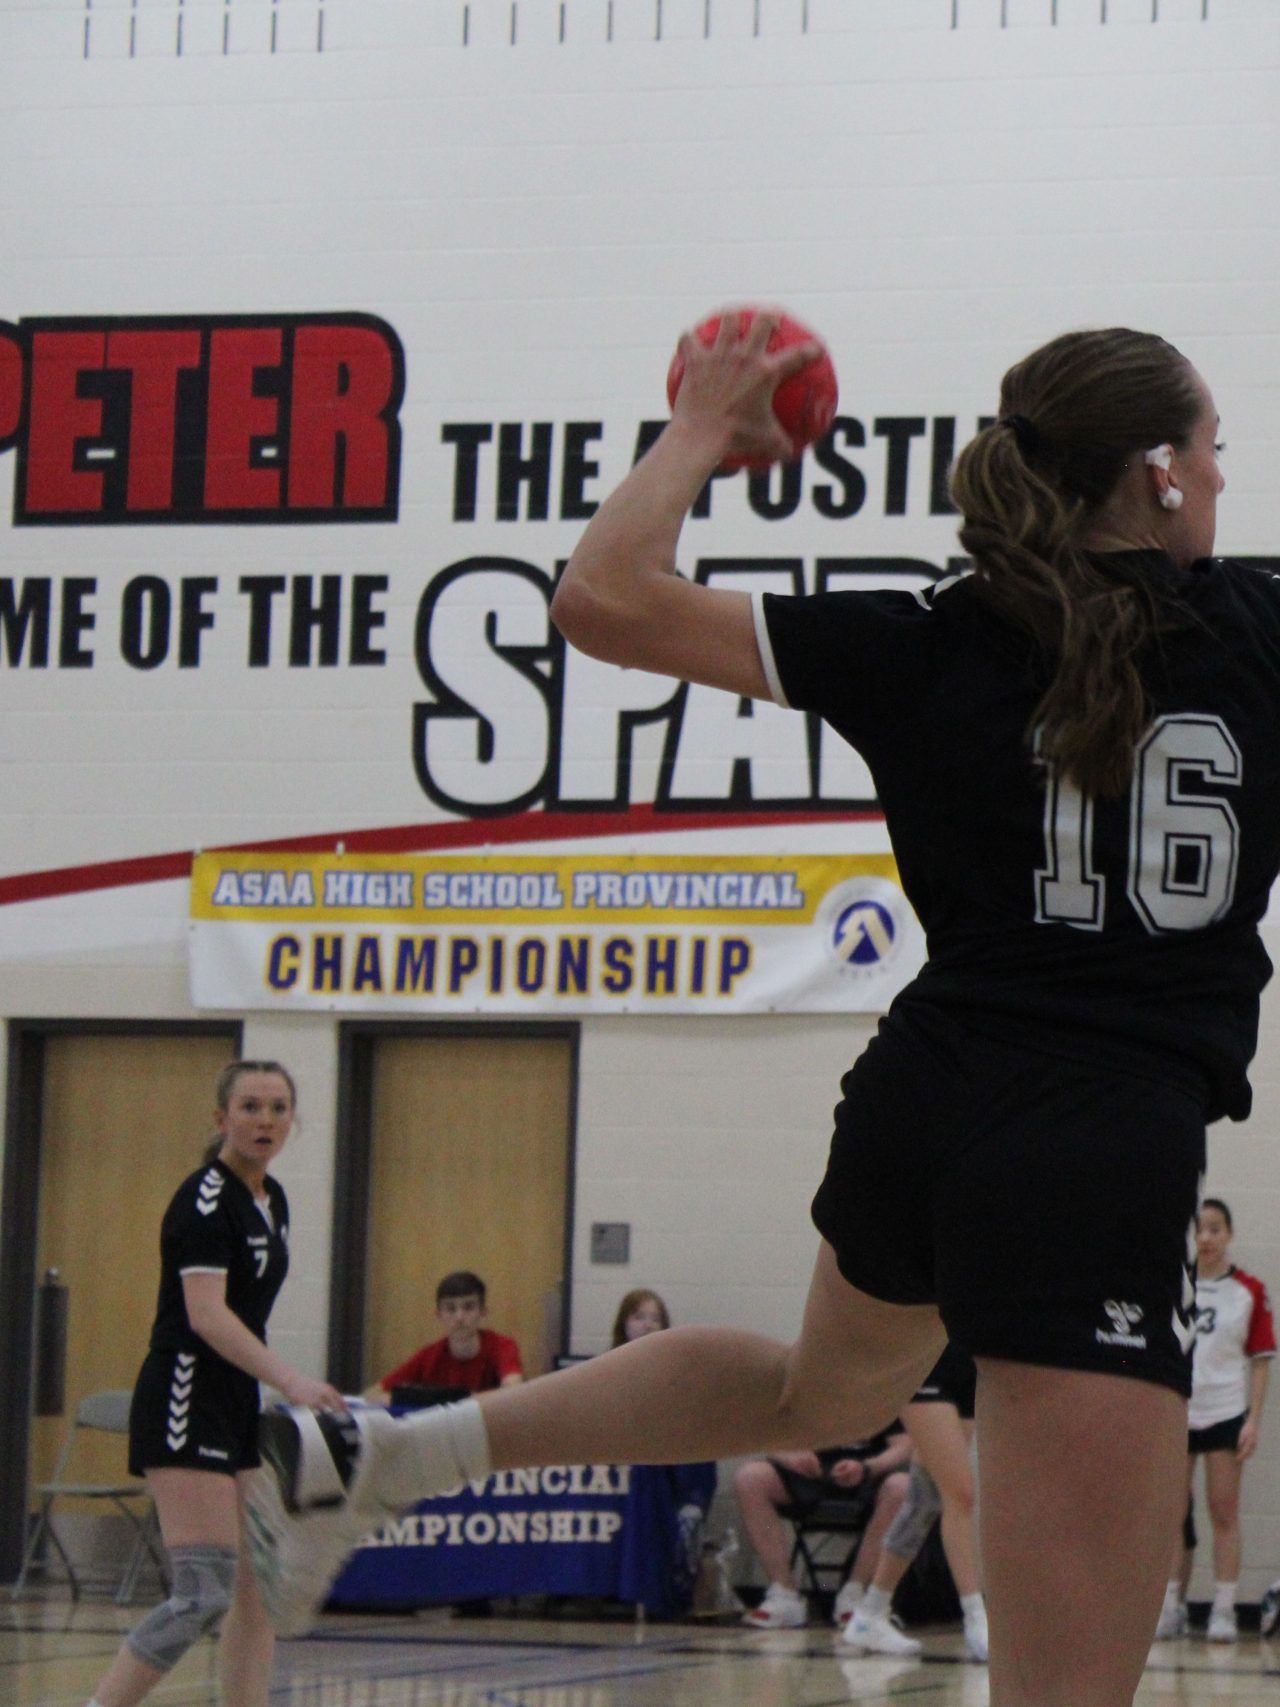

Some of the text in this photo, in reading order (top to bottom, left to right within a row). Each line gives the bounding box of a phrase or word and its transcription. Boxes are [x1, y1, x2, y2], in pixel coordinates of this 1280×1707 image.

[0, 311, 406, 527] ETER
[441, 422, 604, 521] THE
[120, 574, 218, 671] OF
[238, 574, 389, 668] THE
[1033, 712, 1243, 936] 16
[211, 869, 806, 910] ASAA HIGH SCHOOL PROVINCIAL
[264, 931, 755, 996] CHAMPIONSHIP
[254, 1249, 269, 1279] 7
